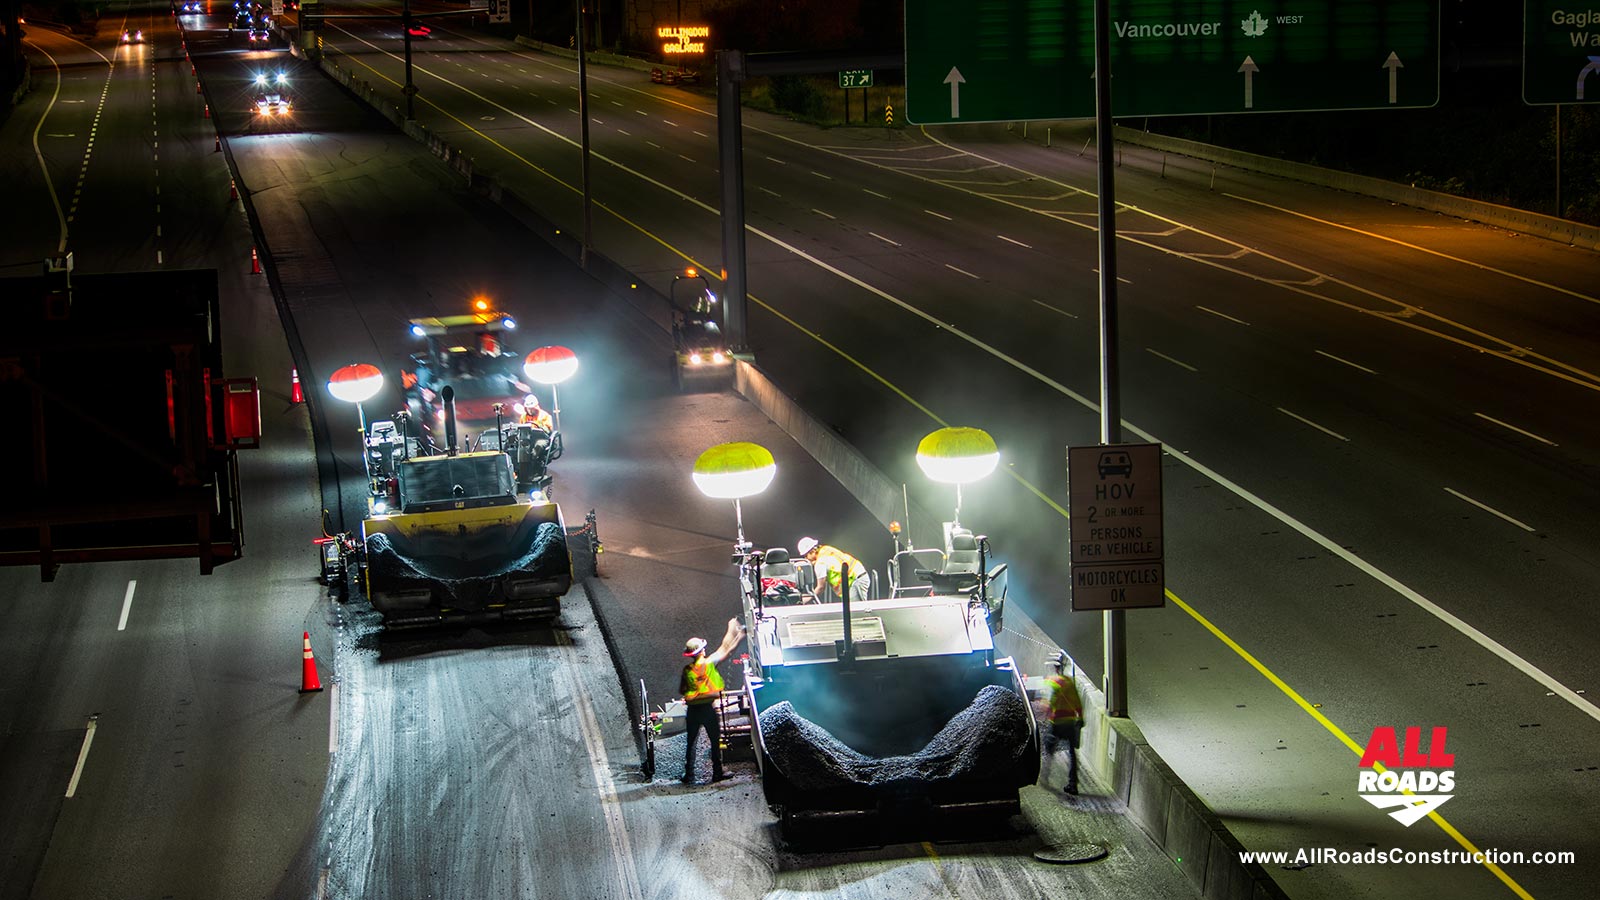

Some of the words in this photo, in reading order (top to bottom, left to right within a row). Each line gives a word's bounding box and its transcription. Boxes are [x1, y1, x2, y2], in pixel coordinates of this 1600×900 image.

[658, 26, 709, 37] WILLINGDON
[1113, 21, 1221, 38] Vancouver
[1276, 15, 1304, 24] WEST
[678, 35, 690, 44] TO
[663, 43, 705, 53] GAGLARDI
[843, 75, 854, 86] 37
[1095, 483, 1135, 500] HOV
[1087, 505, 1097, 523] 2
[1105, 507, 1116, 517] OR
[1121, 506, 1144, 516] MORE
[1090, 526, 1142, 540] PERSONS
[1080, 544, 1101, 556] PER
[1107, 541, 1153, 555] VEHICLE
[1078, 568, 1158, 586] MOTORCYCLES
[1110, 588, 1126, 603] OK
